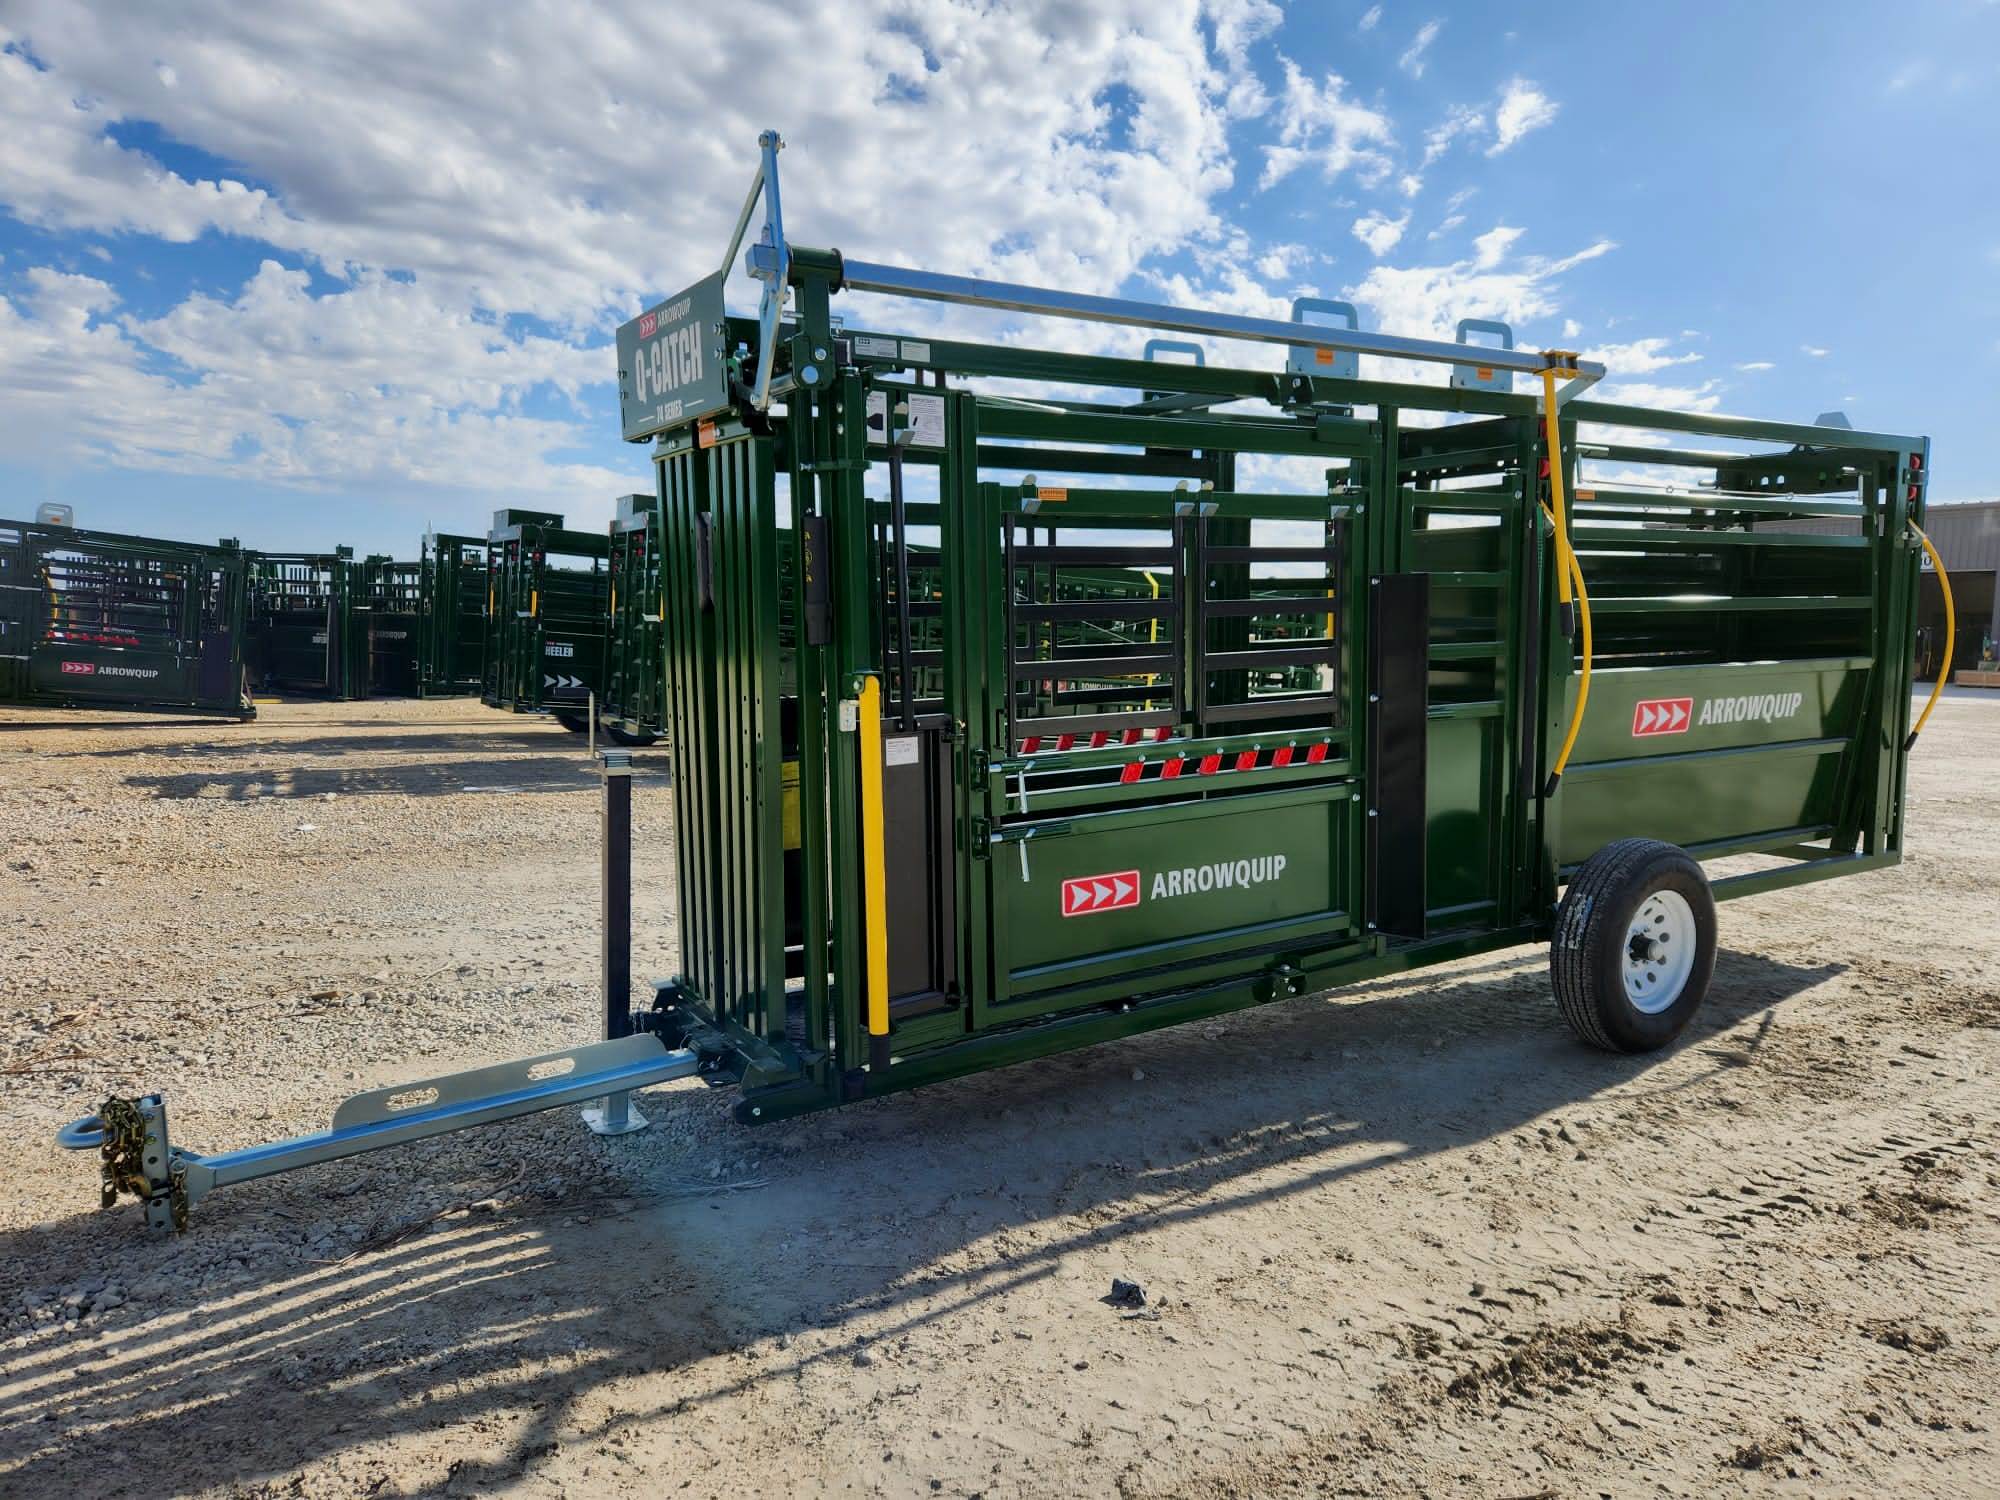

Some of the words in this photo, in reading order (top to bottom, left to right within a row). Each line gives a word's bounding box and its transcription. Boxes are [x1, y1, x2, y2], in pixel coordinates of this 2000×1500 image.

[635, 320, 703, 405] Q-CATCH
[664, 400, 683, 420] SERIES
[98, 666, 158, 679] ARROWQUIP
[1698, 692, 1802, 725] ARROWQUIP
[1150, 854, 1286, 900] ARROWQUIP
